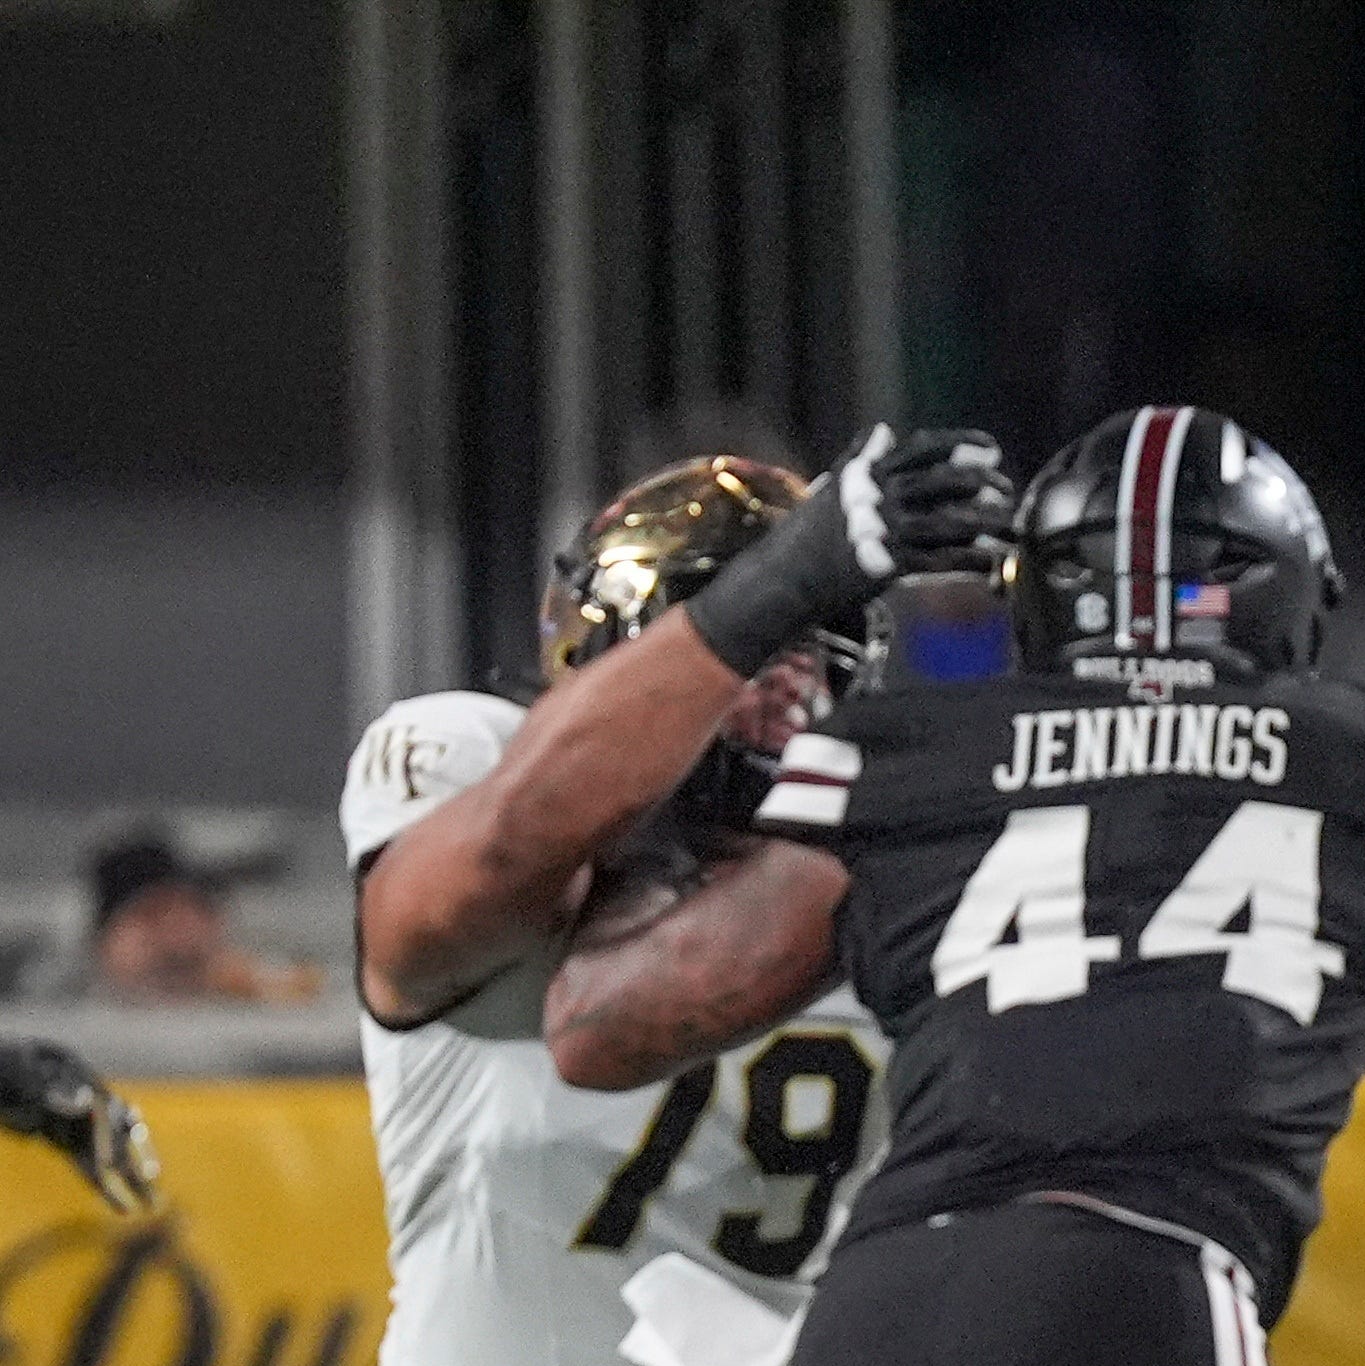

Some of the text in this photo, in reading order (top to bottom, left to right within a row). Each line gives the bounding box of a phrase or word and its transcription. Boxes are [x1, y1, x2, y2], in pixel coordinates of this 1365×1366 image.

[991, 703, 1291, 792] JENNINGS
[929, 800, 1348, 1028] 44
[566, 1025, 882, 1280] 79
